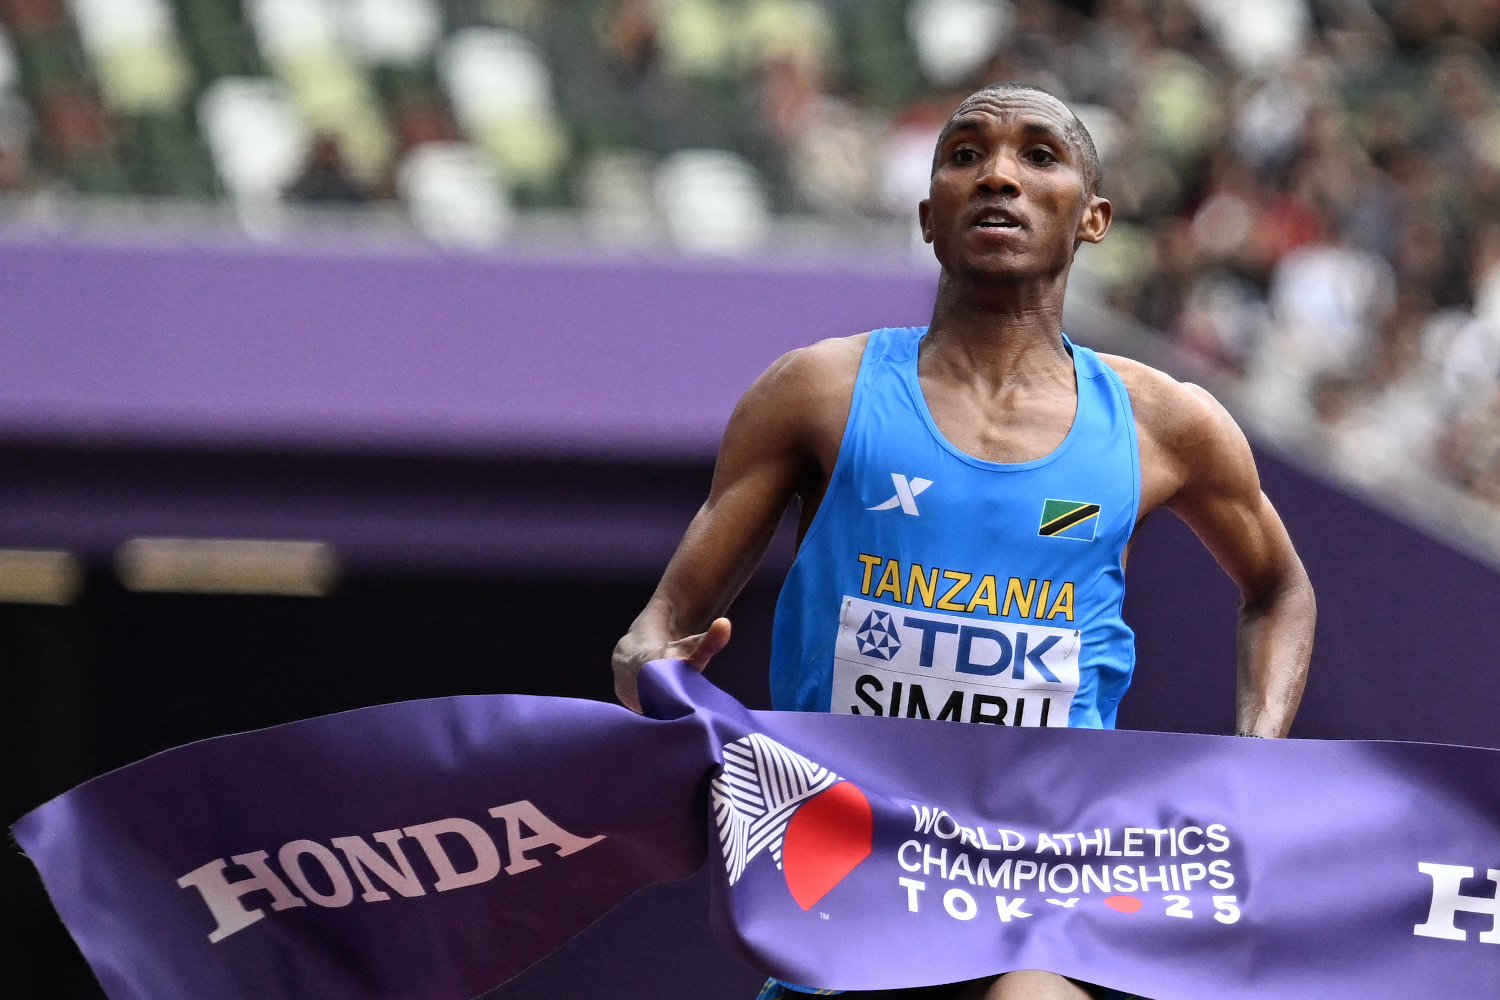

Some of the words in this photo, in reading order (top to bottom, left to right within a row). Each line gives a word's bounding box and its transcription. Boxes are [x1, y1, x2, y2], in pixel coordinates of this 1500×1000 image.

[857, 553, 1076, 621] TANZANIA
[903, 615, 1063, 683] TDK
[910, 804, 1026, 851] WORLD
[1035, 824, 1230, 857] ATHLETICS
[177, 800, 607, 943] HONDA
[898, 839, 1235, 894] CHAMPIONSHIPS
